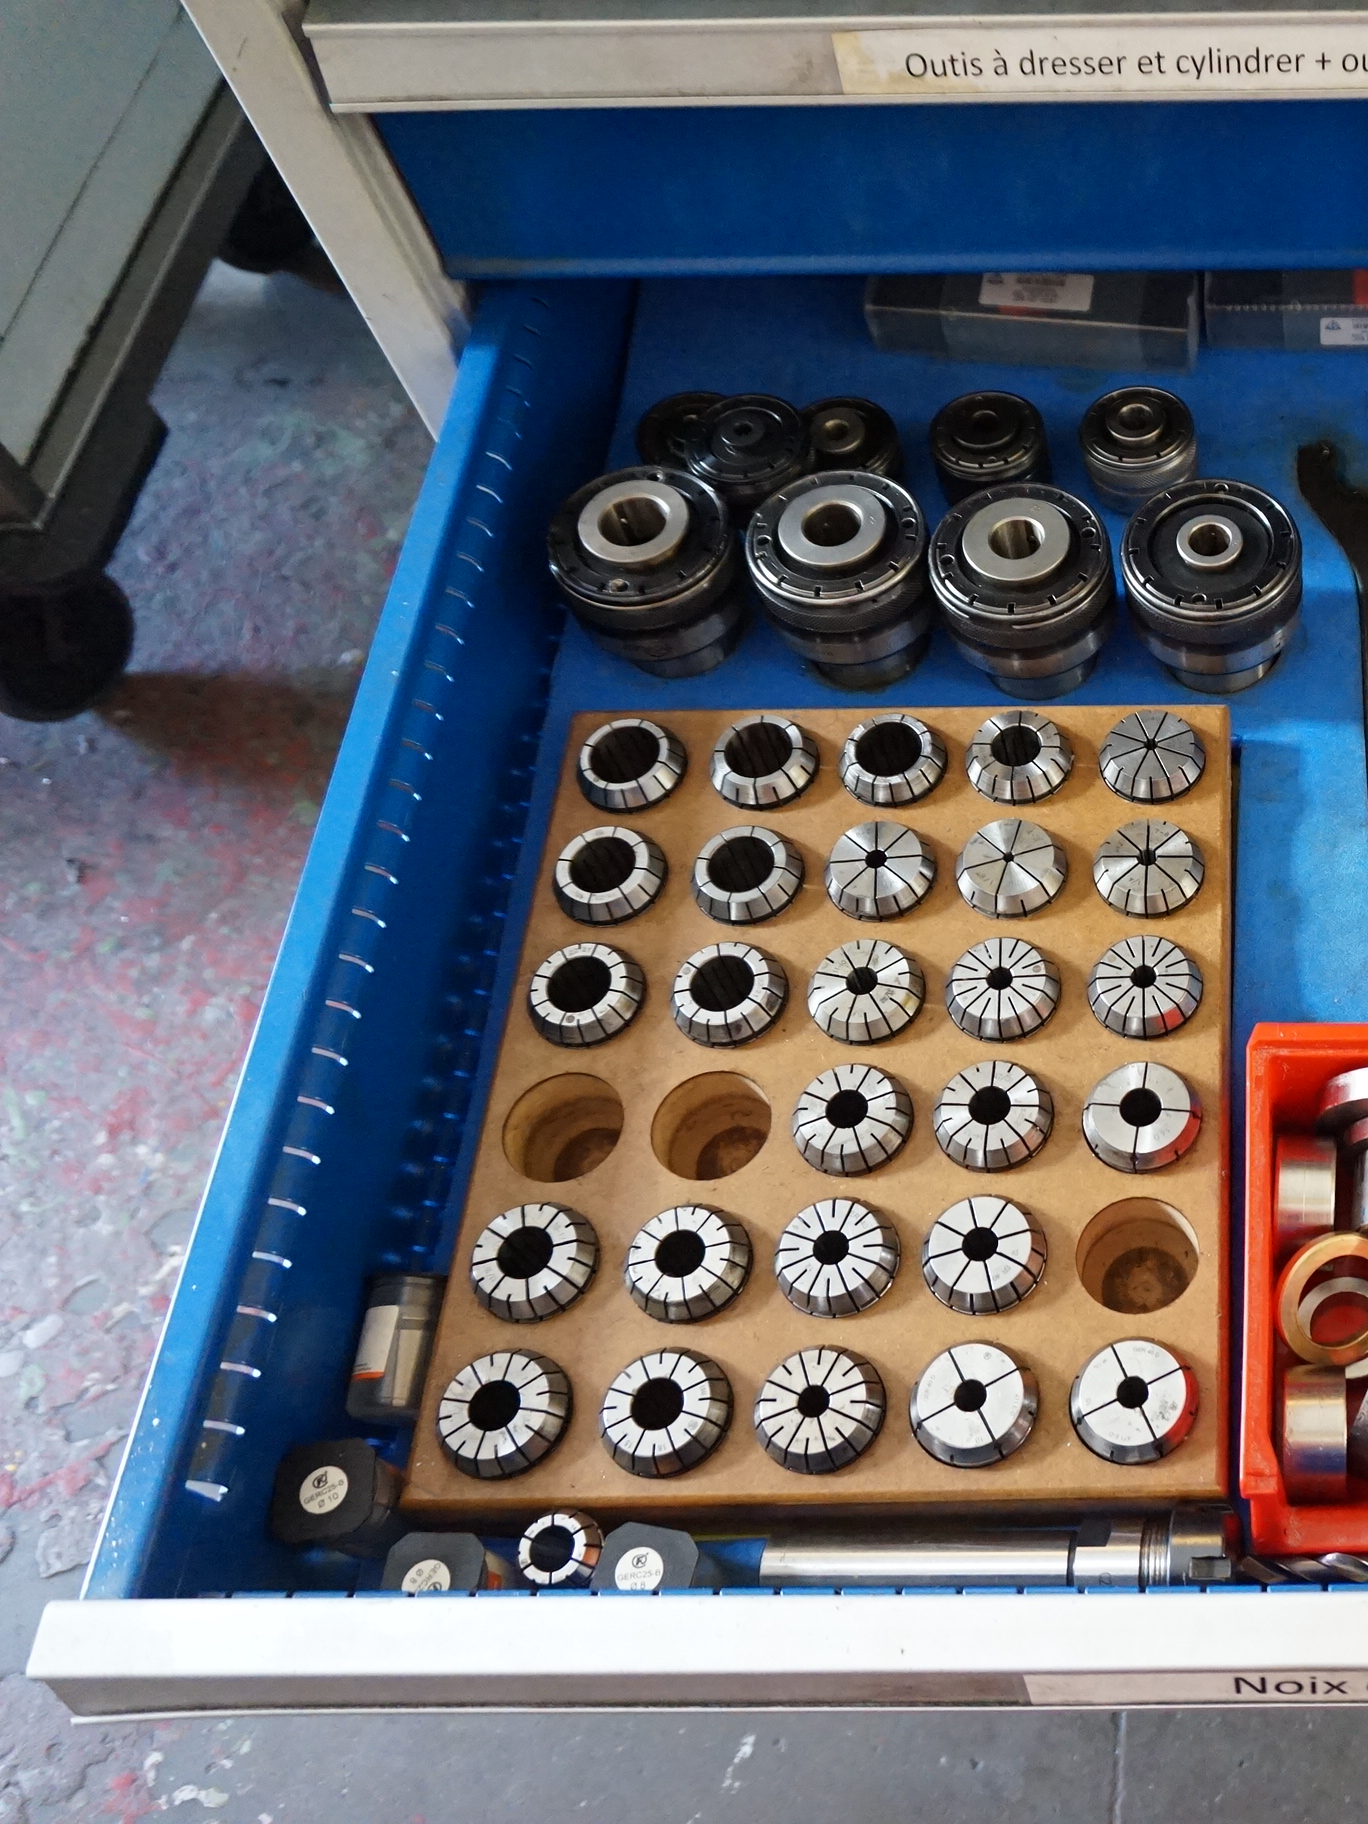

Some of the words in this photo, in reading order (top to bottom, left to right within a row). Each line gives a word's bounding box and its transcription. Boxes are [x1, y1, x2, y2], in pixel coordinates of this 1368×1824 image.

[905, 52, 983, 78] Outis
[993, 49, 1009, 76] à
[1019, 48, 1127, 76] dresser
[1137, 51, 1166, 75] et
[1176, 46, 1305, 80] cylindrer
[1315, 52, 1332, 71] +
[328, 1491, 339, 1502] 10
[1233, 1676, 1349, 1695] Noix
